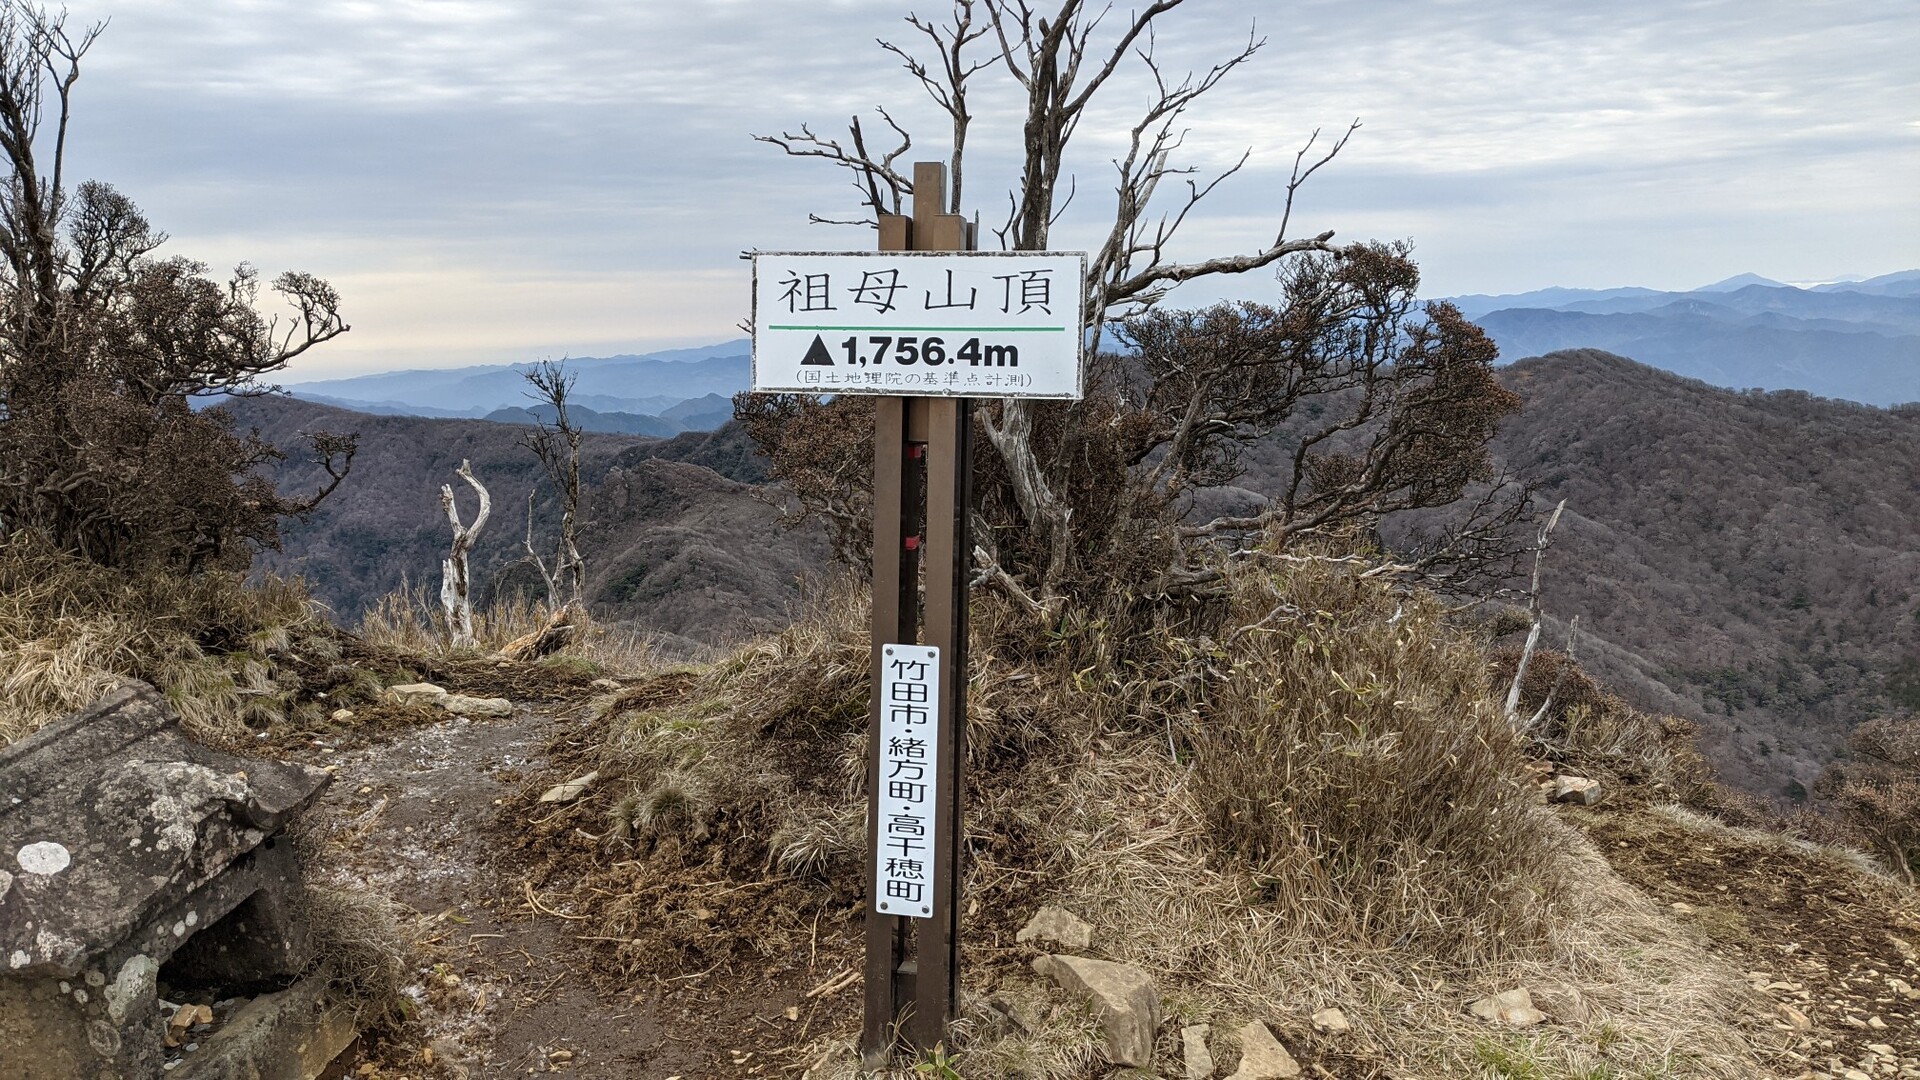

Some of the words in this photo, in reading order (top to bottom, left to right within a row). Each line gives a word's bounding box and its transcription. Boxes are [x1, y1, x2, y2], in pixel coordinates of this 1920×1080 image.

[777, 268, 1054, 315] 祖母山頂
[841, 336, 1019, 367] 1,756.4m
